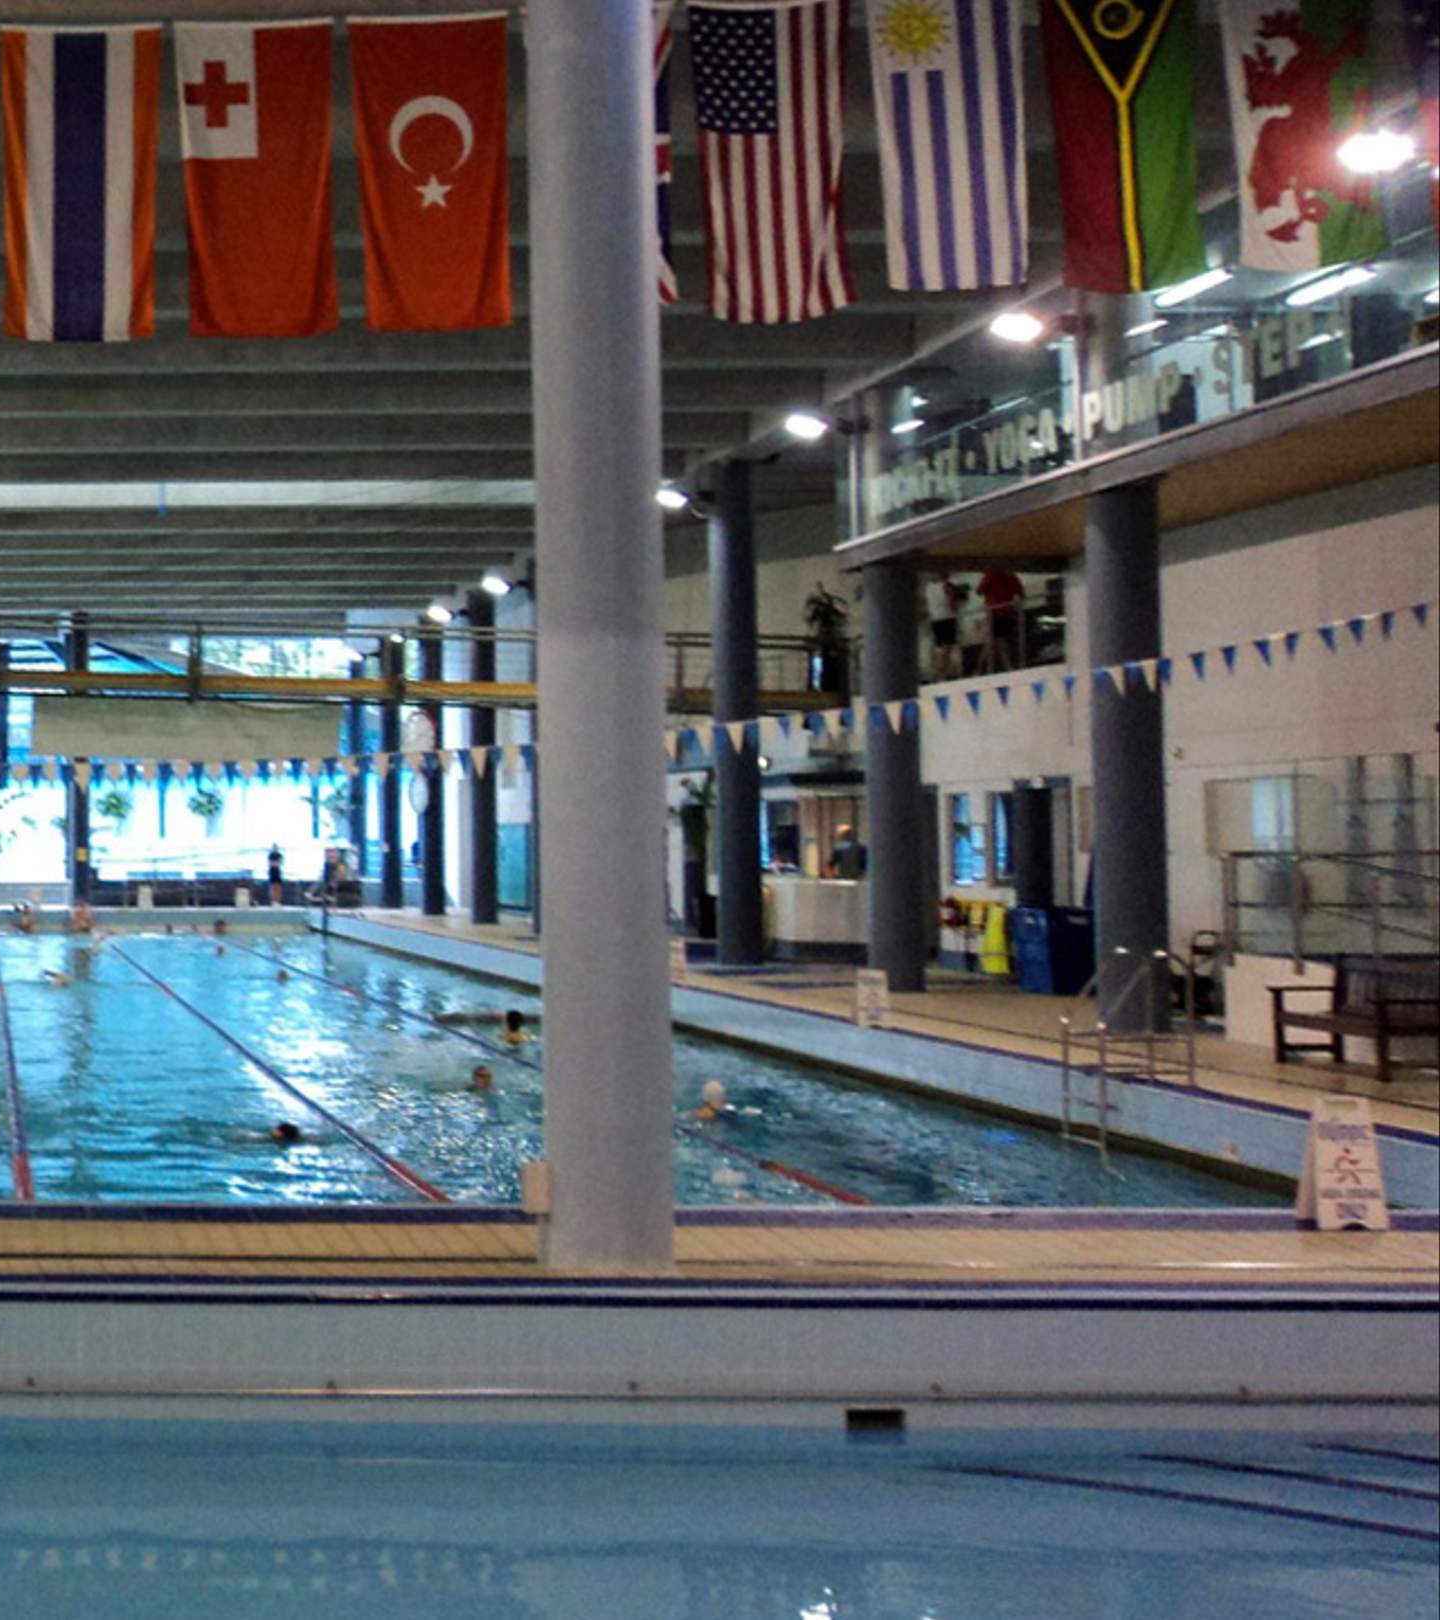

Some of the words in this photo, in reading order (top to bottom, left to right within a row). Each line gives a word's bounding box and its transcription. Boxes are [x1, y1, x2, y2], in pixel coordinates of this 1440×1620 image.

[983, 408, 1059, 475] YOGA
[1083, 360, 1182, 441] PUMP
[1212, 311, 1310, 395] STEP
